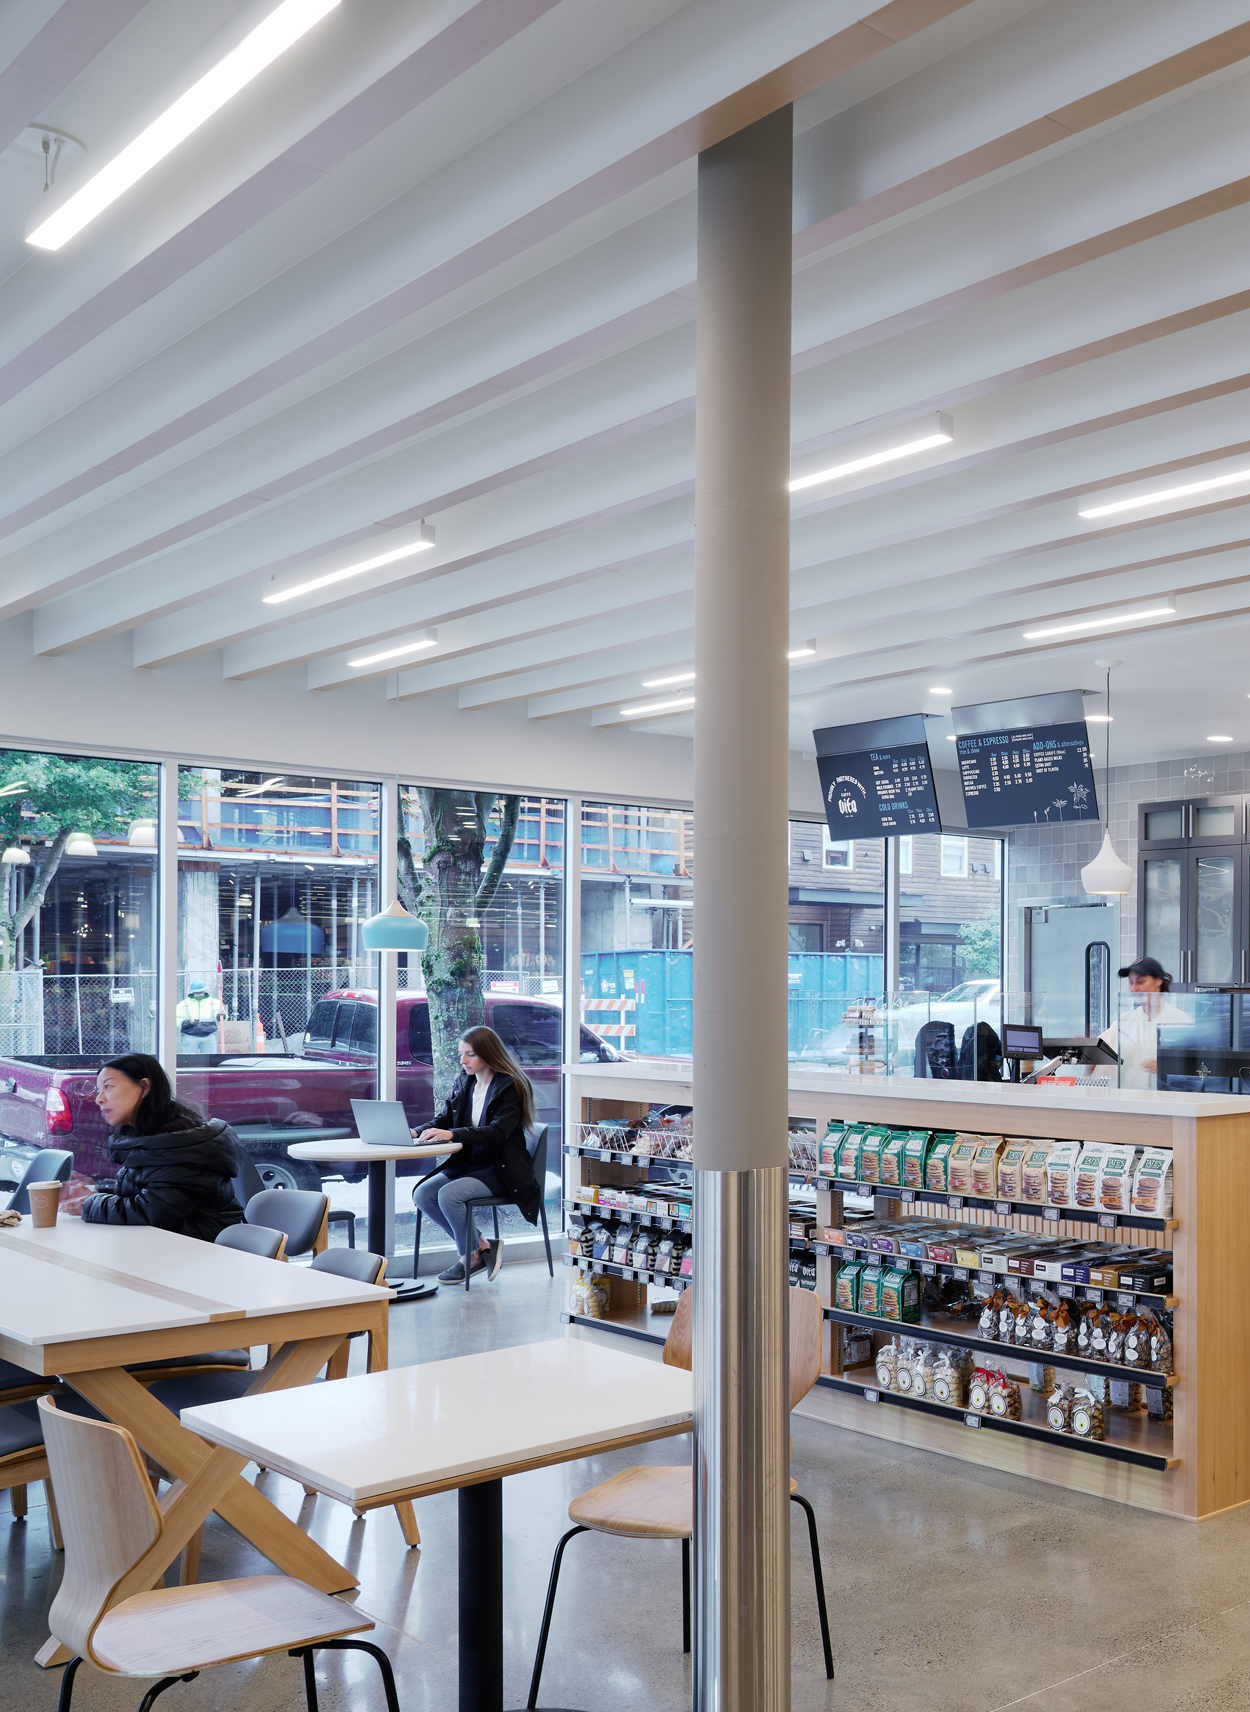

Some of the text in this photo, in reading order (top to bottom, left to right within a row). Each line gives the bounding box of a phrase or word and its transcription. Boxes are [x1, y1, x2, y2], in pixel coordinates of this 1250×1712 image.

[958, 740, 977, 749] COFFEE
[983, 736, 1009, 746] ESPRESSO
[1032, 740, 1056, 750] ADD-ONS
[836, 775, 858, 785] PARTNERED
[878, 801, 908, 811] COLD DRINKS
